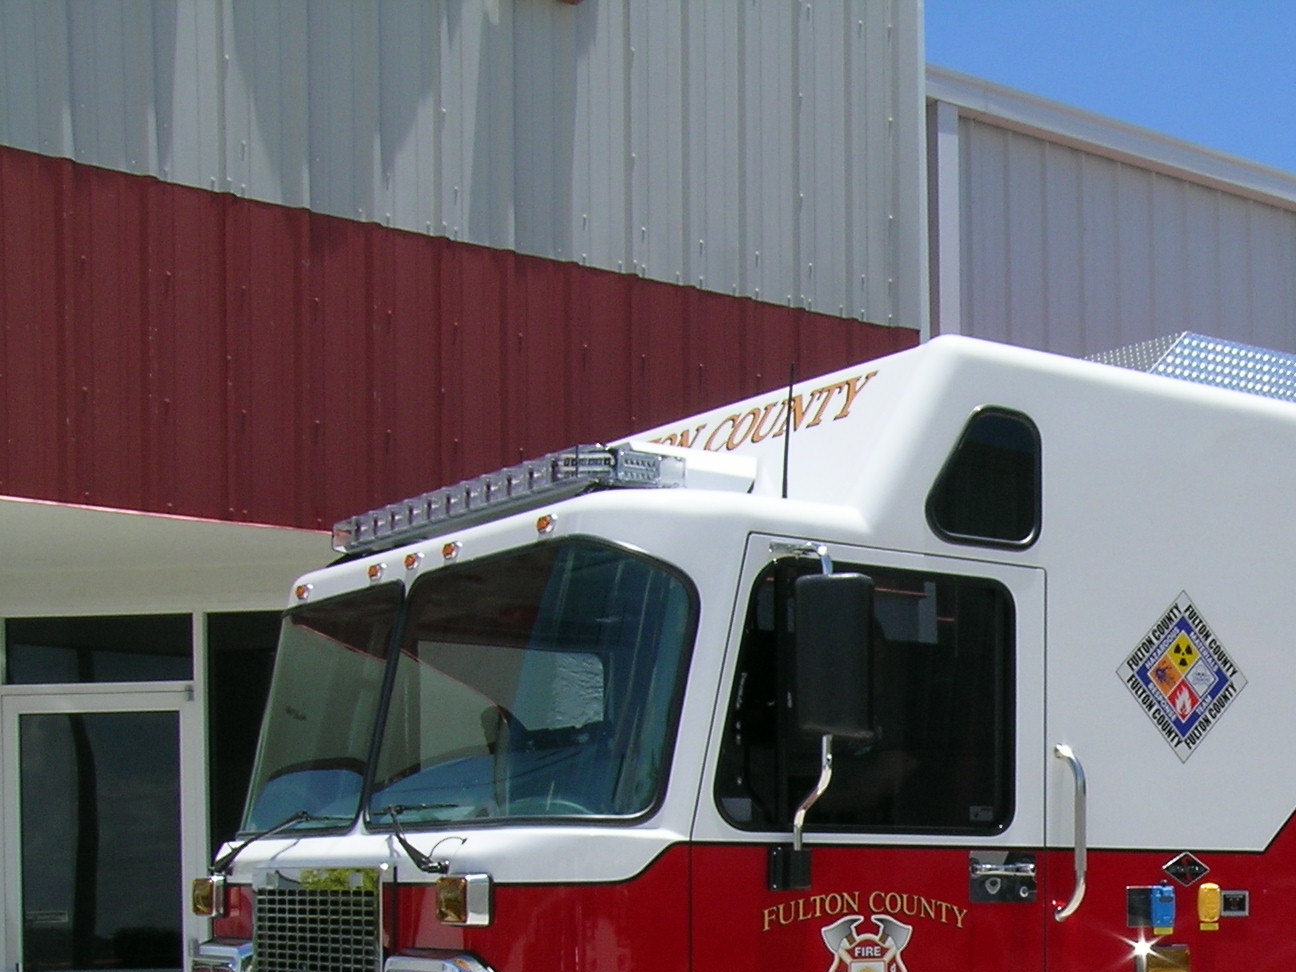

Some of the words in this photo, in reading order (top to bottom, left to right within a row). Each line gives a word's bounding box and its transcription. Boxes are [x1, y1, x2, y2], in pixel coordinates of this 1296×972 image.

[703, 371, 878, 451] COUNTY
[1127, 636, 1156, 671] FULTON
[1152, 603, 1182, 641] COUNTY
[1184, 604, 1212, 642] FULTON
[1208, 638, 1238, 678] COUNTY
[1126, 674, 1156, 712] FULTON
[1151, 708, 1183, 748] COUNTY
[1184, 714, 1212, 750] FULTON
[1208, 681, 1238, 719] COUNTY
[761, 891, 859, 932] FULTON
[869, 891, 967, 929] COUNTY
[854, 946, 881, 958] FIRE
